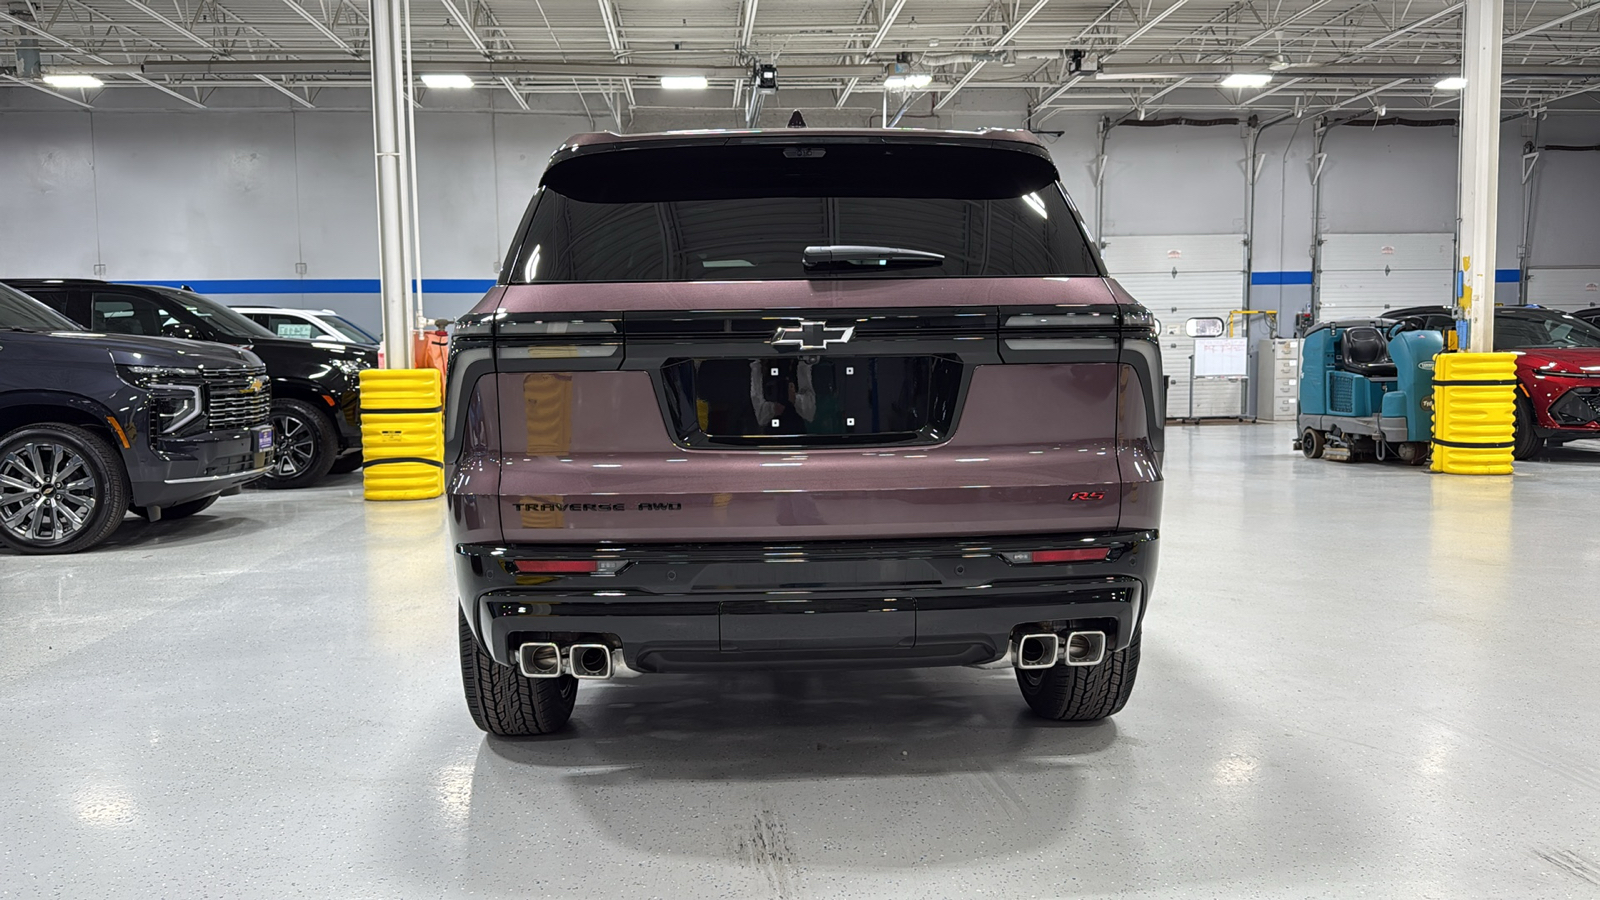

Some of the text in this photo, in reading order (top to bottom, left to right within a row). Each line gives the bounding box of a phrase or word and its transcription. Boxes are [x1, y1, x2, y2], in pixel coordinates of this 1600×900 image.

[1068, 491, 1106, 501] RS
[512, 502, 682, 512] TRAVERSE AWD
